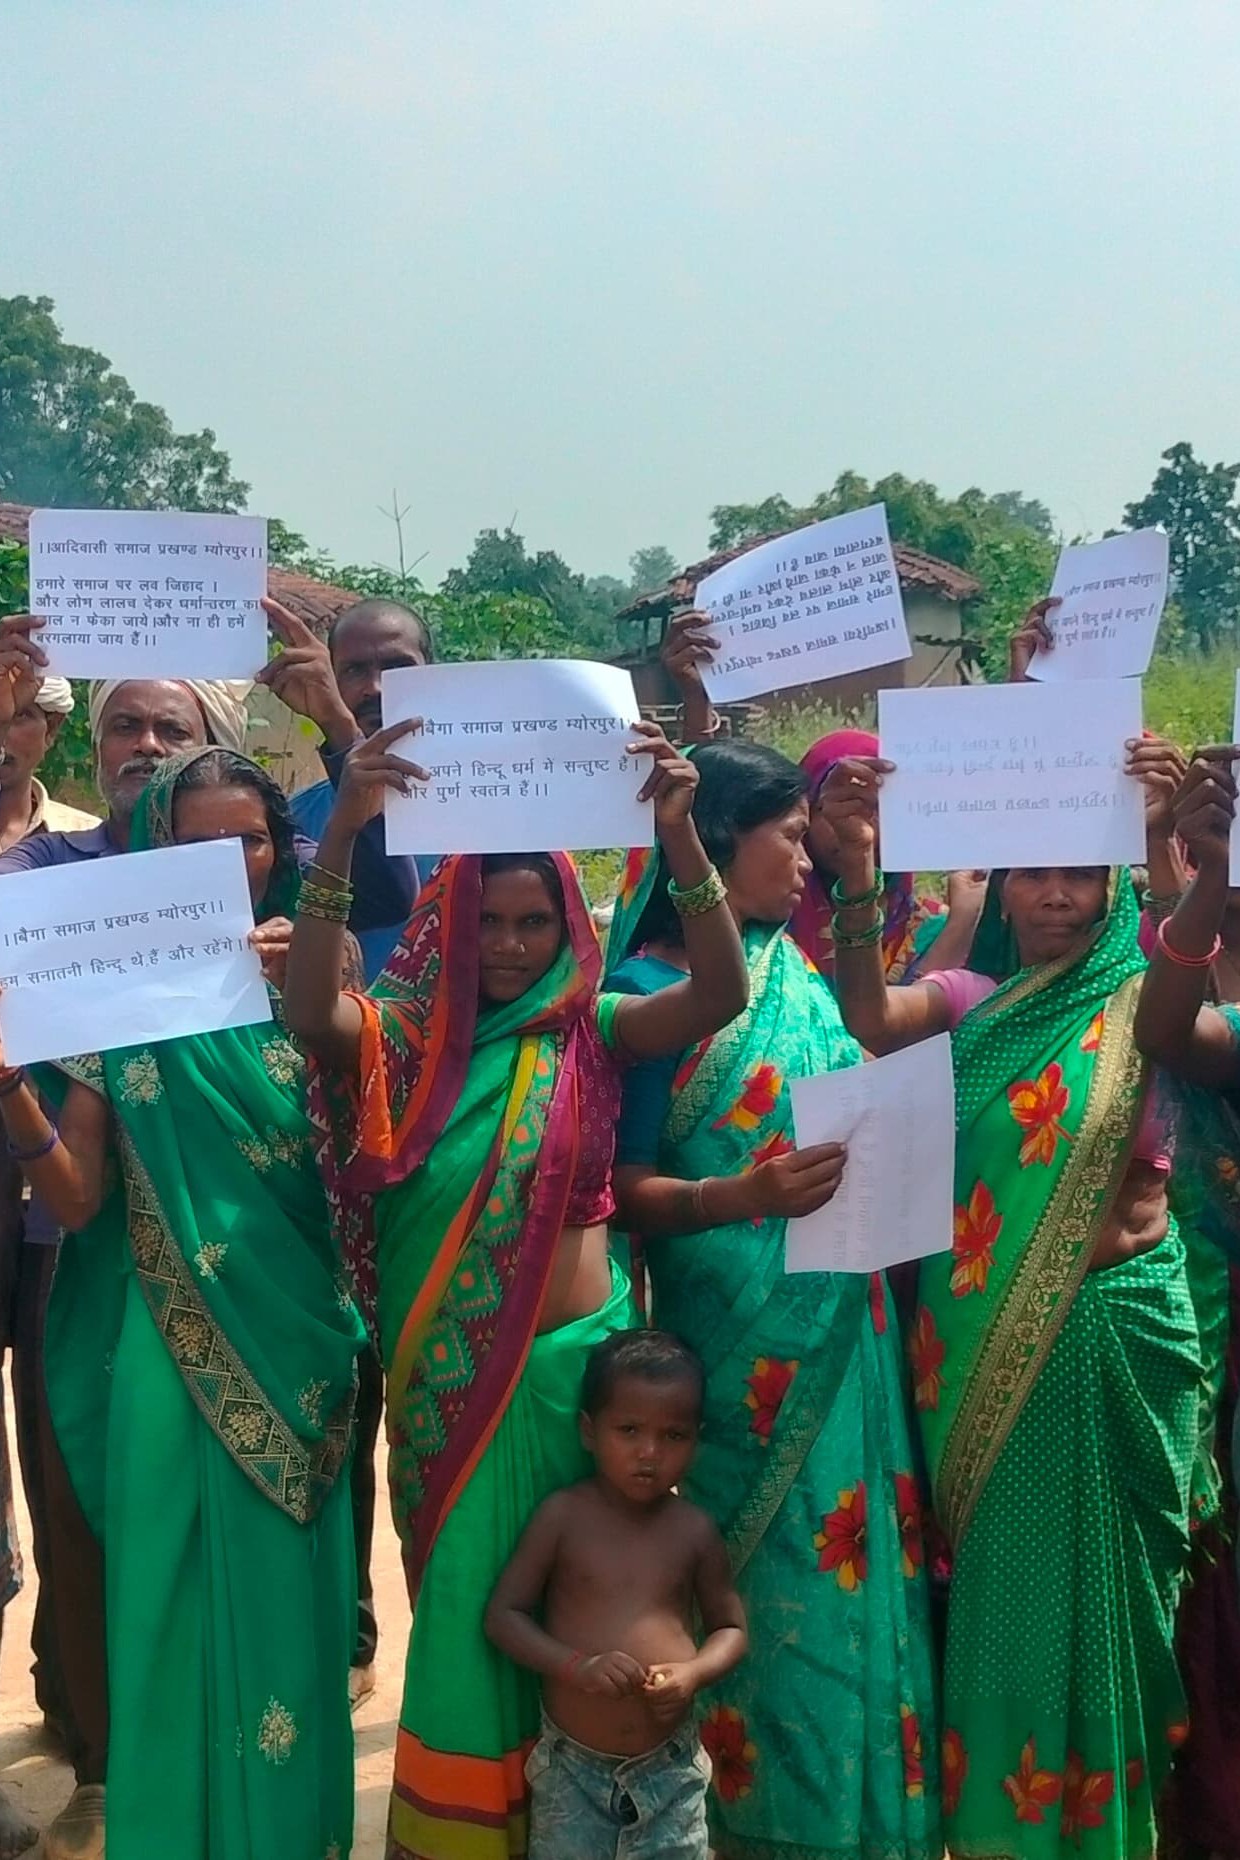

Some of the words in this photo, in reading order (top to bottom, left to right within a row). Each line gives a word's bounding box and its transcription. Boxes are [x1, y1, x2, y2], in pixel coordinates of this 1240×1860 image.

[40, 539, 107, 554] ।।आदिवासी
[114, 543, 151, 554] समाज
[157, 544, 197, 555] प्रखण्ड
[204, 542, 262, 560] म्योरपुर।।
[861, 553, 888, 567] जाल
[35, 575, 66, 590] हमारे
[72, 579, 109, 591] समाज
[115, 580, 132, 591] पर
[138, 580, 158, 591] लव
[165, 577, 204, 592] जिहाद
[869, 569, 891, 584] और
[35, 592, 59, 608] और
[99, 598, 137, 609] लालच
[143, 594, 173, 610] देकर
[179, 595, 236, 610] धर्मान्तरण
[767, 595, 794, 610] देकर
[826, 594, 860, 611] समाज
[866, 585, 893, 603] हमारे
[782, 609, 801, 623] लव
[805, 605, 821, 616] पर
[86, 612, 116, 627] फेका
[122, 612, 148, 627] जाये
[186, 617, 201, 628] ना
[206, 613, 220, 628] ही
[227, 613, 246, 629] हमें
[742, 615, 777, 633] जिहाद
[97, 634, 124, 645] जाय
[805, 635, 838, 651] समाज
[766, 645, 801, 661] प्रखण्ड
[460, 721, 503, 734] समाज
[512, 720, 558, 733] प्रखण्ड
[471, 760, 507, 780] हिन्दू
[512, 758, 534, 775] धर्म
[543, 757, 553, 773] में
[564, 760, 609, 776] सन्तुष्ट
[436, 781, 461, 803] पुर्ण
[469, 784, 510, 797] स्वतंत्र
[4, 927, 46, 947] ।।बैगा
[53, 920, 96, 937] समाज
[104, 912, 149, 930] प्रखण्ड
[156, 900, 224, 920] म्योरपुर।।
[26, 962, 82, 984] सनातनी
[90, 958, 127, 974] हिन्दू
[168, 944, 195, 960] और
